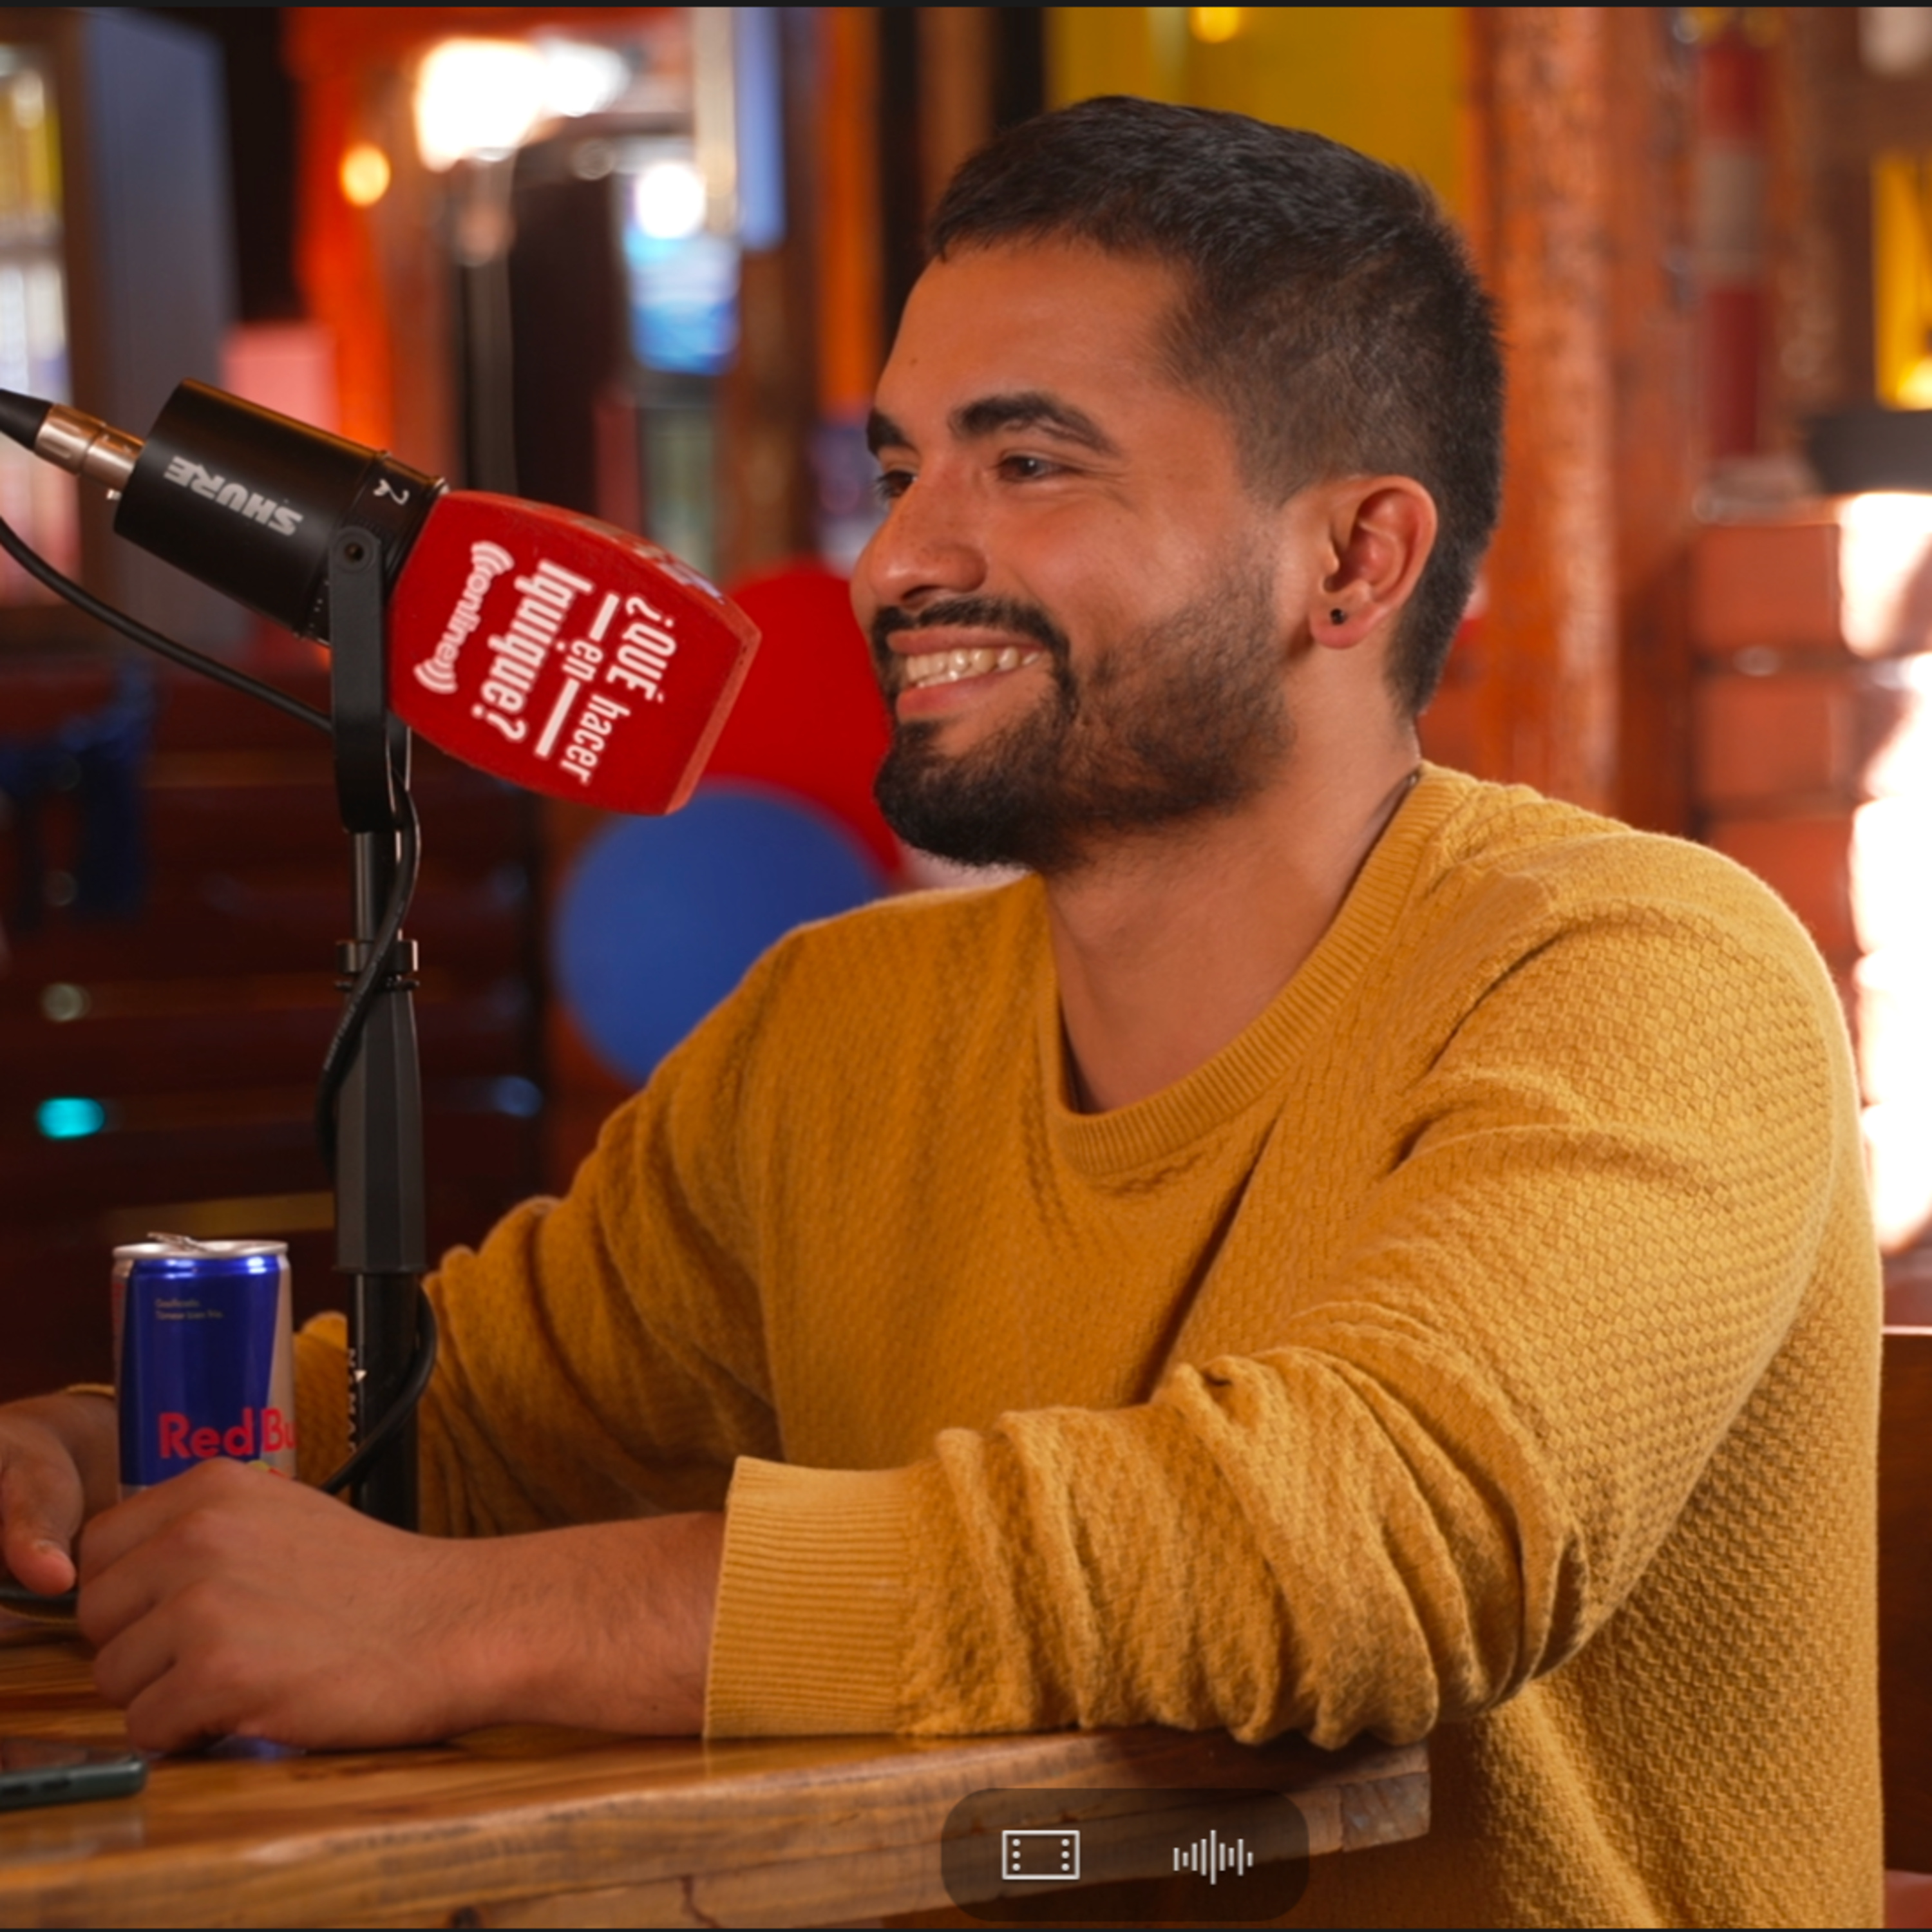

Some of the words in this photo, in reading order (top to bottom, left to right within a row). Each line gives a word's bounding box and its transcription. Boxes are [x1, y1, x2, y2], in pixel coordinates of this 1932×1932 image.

[164, 456, 303, 536] SHURE
[470, 559, 594, 743] Iquique?
[562, 639, 603, 682] en
[605, 596, 677, 703] ¿QUÉ
[560, 694, 632, 785] hacer
[158, 1407, 255, 1459] Red
